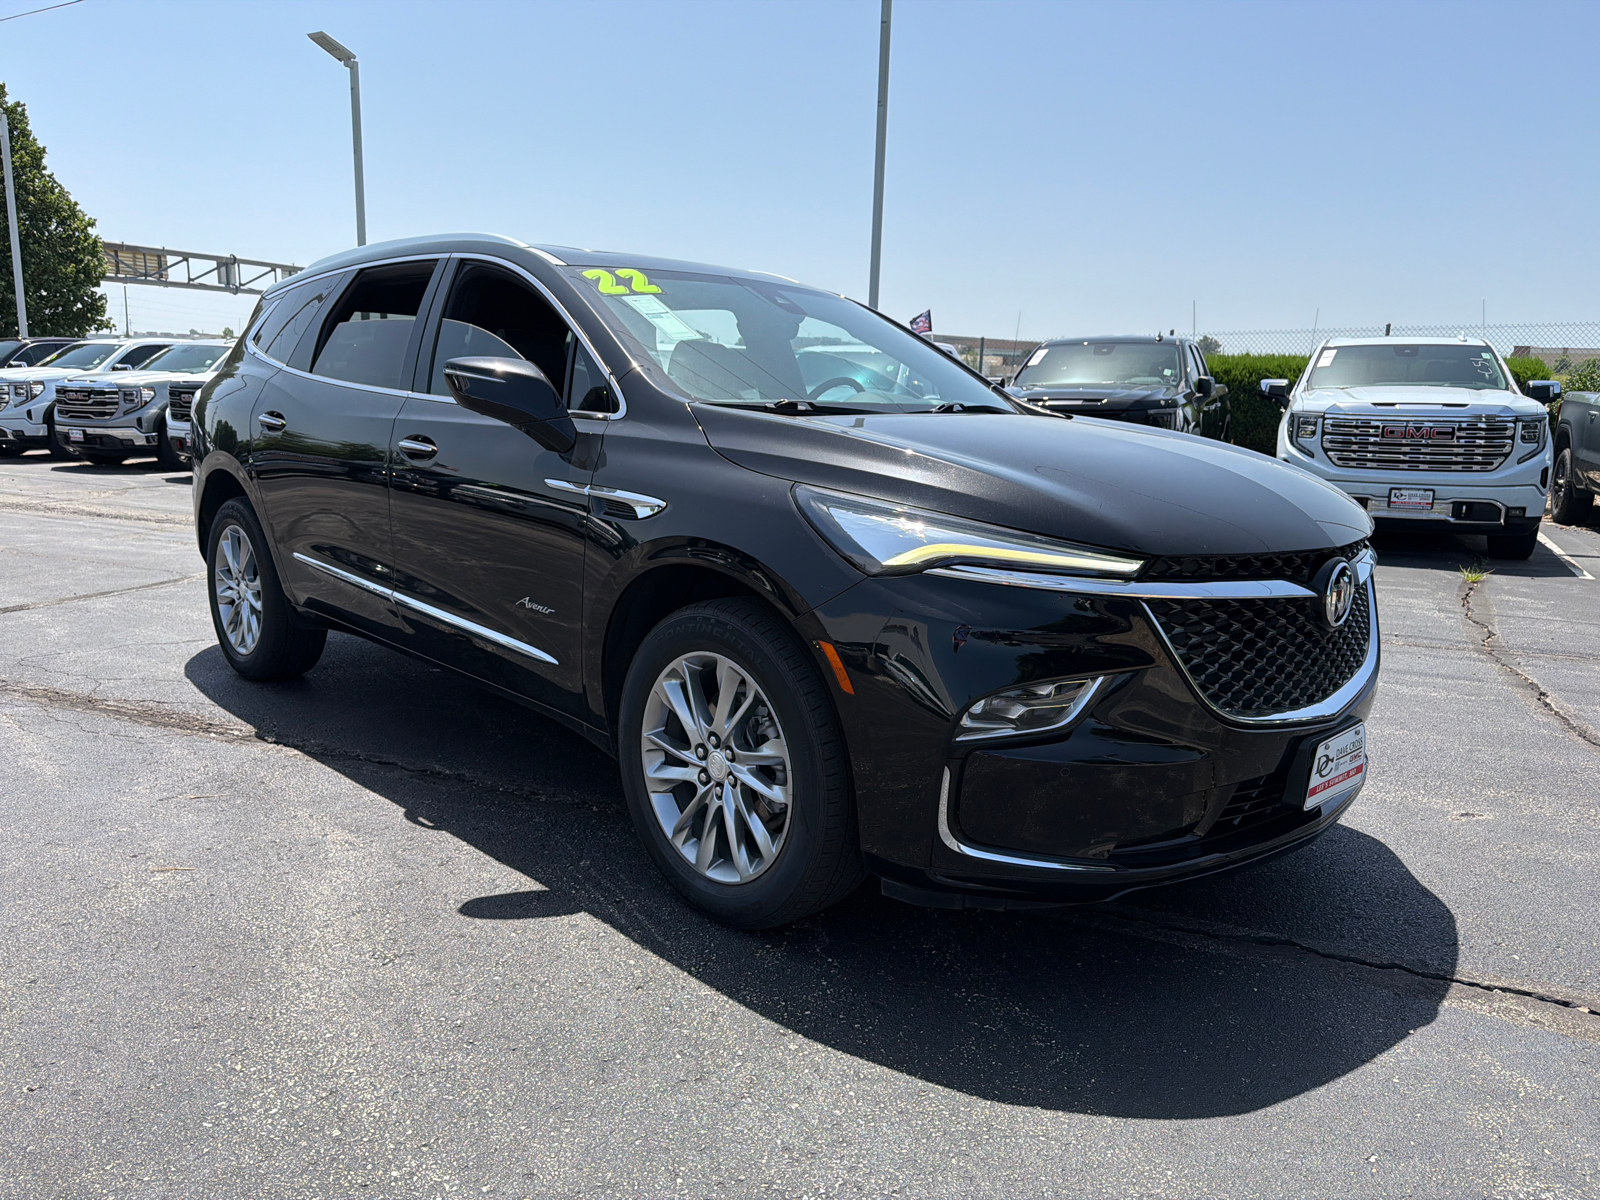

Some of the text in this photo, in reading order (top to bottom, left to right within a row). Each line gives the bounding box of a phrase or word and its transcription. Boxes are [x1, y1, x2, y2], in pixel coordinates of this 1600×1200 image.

[582, 268, 662, 294] 22
[65, 391, 89, 400] GMC
[1384, 426, 1453, 439] GMC
[515, 596, 556, 614] Avenir
[655, 622, 764, 672] CONTINENTAL
[1335, 737, 1363, 758] DAVE CROSS
[1349, 750, 1362, 762] GMC
[1316, 781, 1329, 793] LEE'S
[1349, 768, 1357, 778] MO
